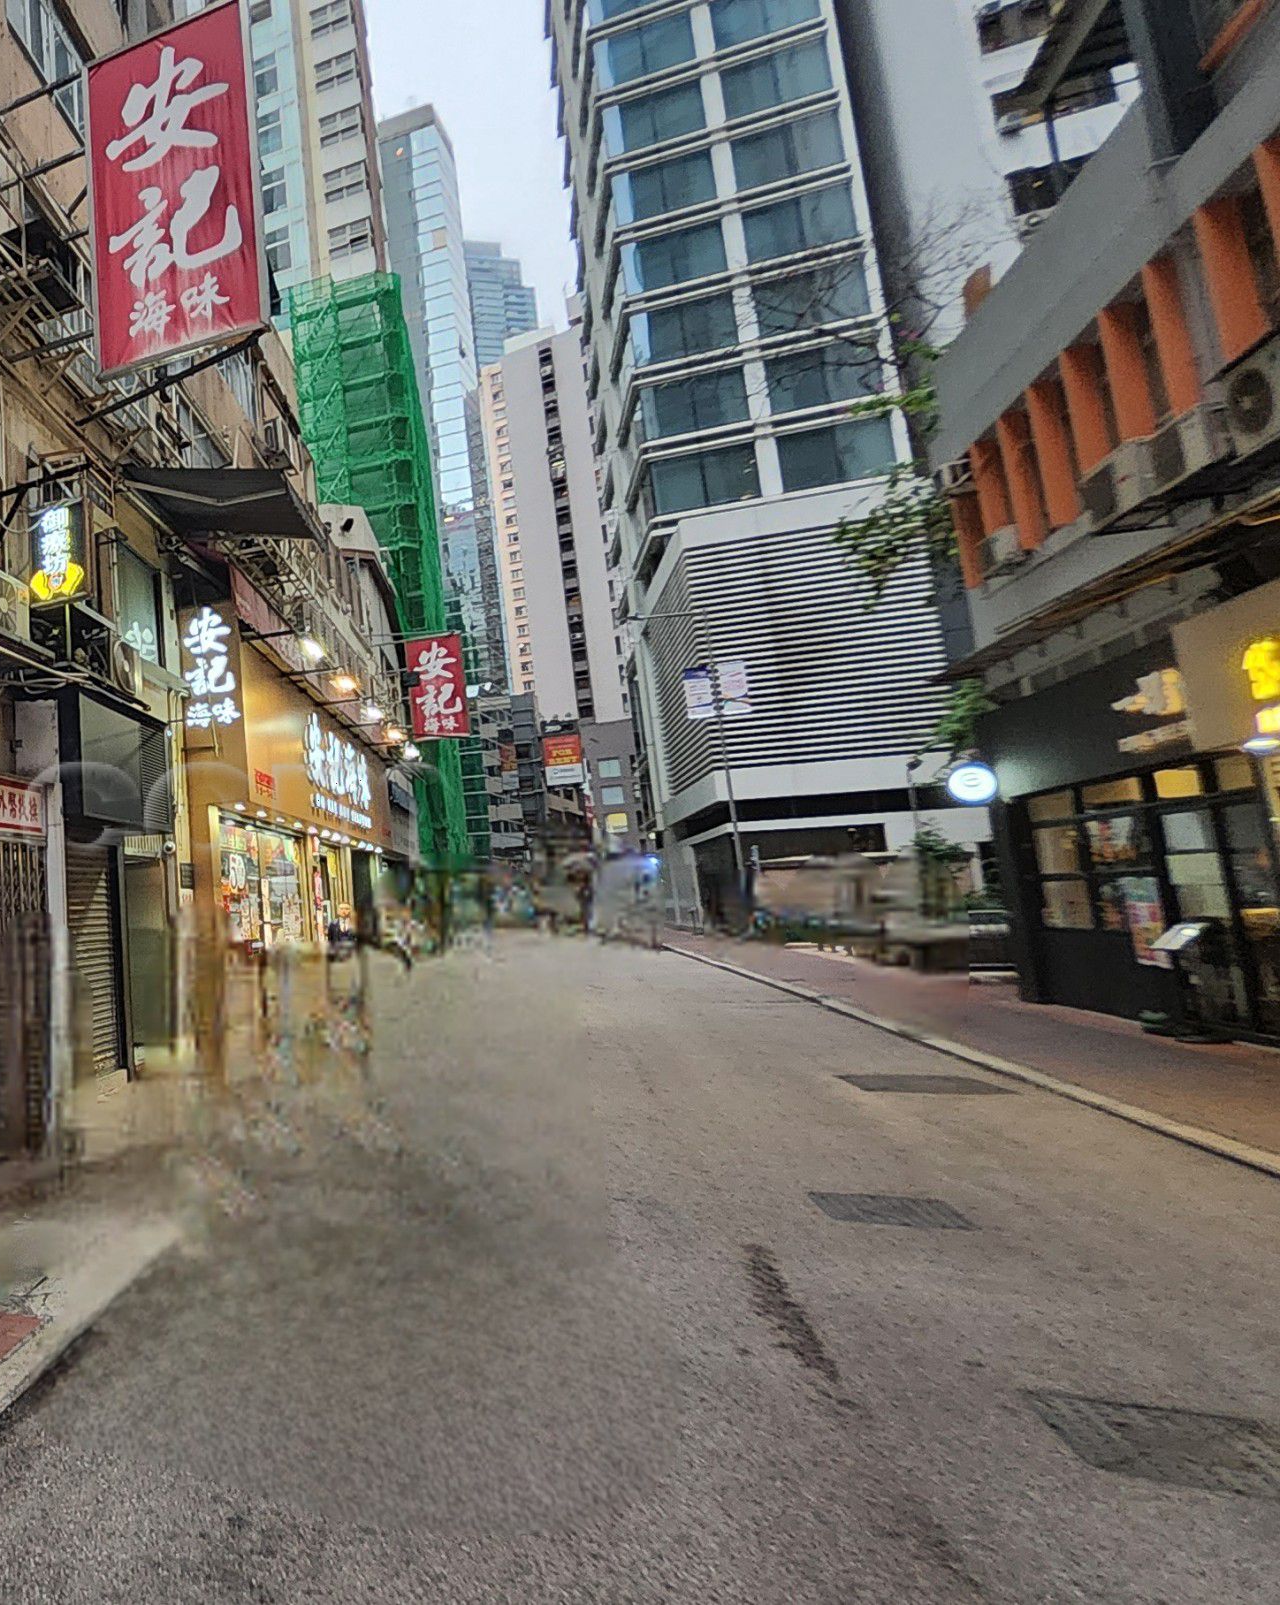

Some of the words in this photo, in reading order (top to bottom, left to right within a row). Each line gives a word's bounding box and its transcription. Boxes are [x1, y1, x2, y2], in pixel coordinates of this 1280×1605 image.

[106, 46, 243, 288] 安記
[129, 271, 230, 338] 海味
[183, 606, 236, 696] 安記
[413, 641, 463, 717] 安記
